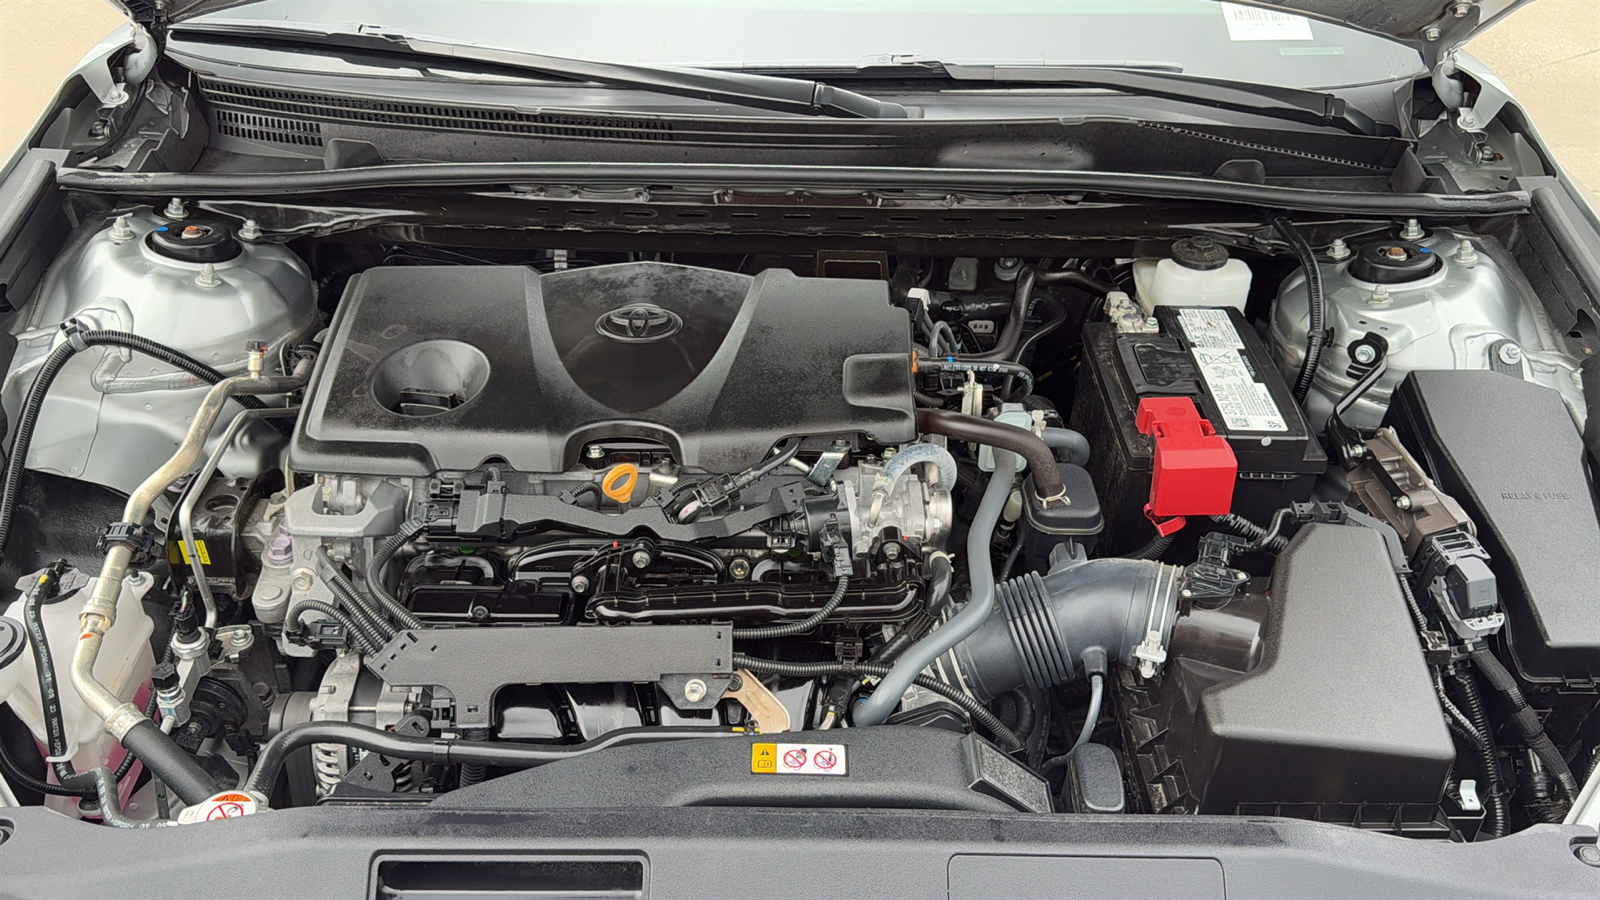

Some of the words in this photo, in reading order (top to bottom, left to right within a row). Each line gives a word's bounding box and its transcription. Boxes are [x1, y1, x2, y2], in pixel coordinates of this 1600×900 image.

[1500, 492, 1532, 500] RELAY
[1542, 492, 1570, 500] FUSE
[32, 621, 43, 641] WATER
[52, 716, 60, 738] WATER
